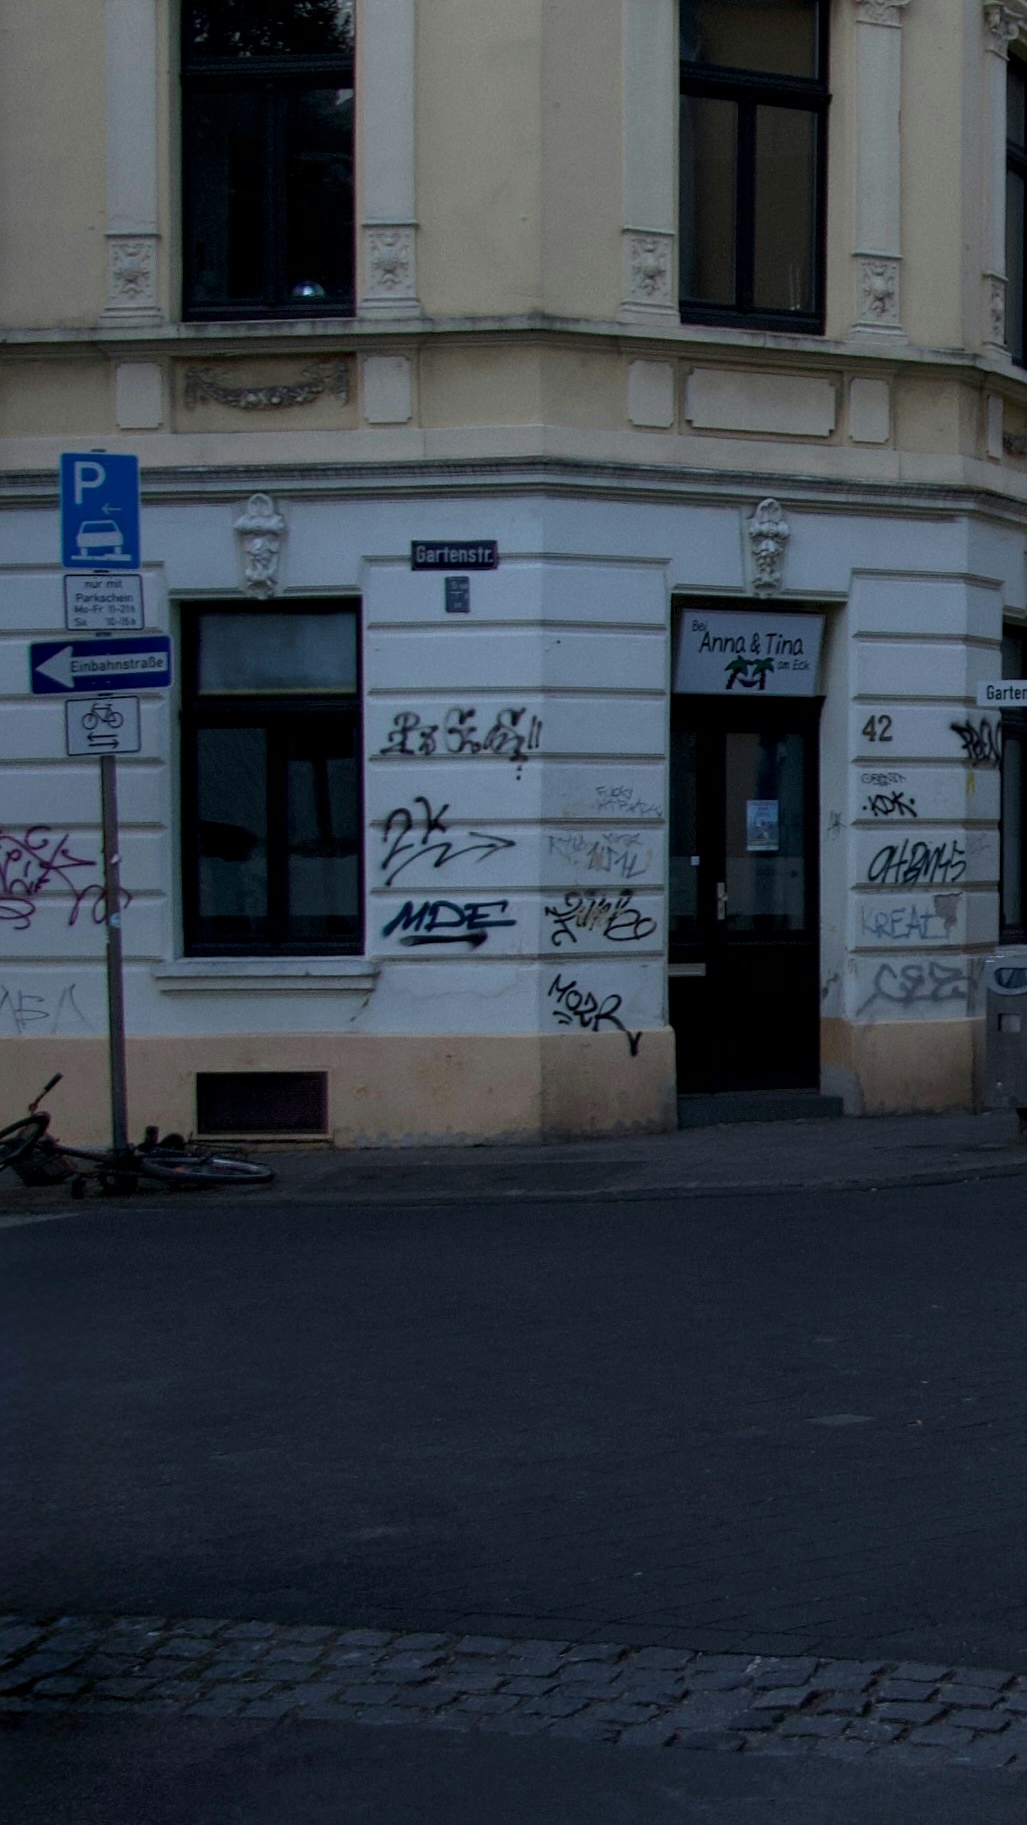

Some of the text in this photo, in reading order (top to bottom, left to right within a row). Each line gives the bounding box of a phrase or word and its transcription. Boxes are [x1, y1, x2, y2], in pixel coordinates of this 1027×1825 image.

[74, 461, 106, 504] P
[416, 546, 494, 563] Gartenstr.
[85, 580, 102, 589] nur
[75, 592, 134, 603] Parkschein
[699, 631, 804, 656] Anna & Tina
[71, 656, 164, 674] Einbahnstraße
[862, 714, 894, 742] 42
